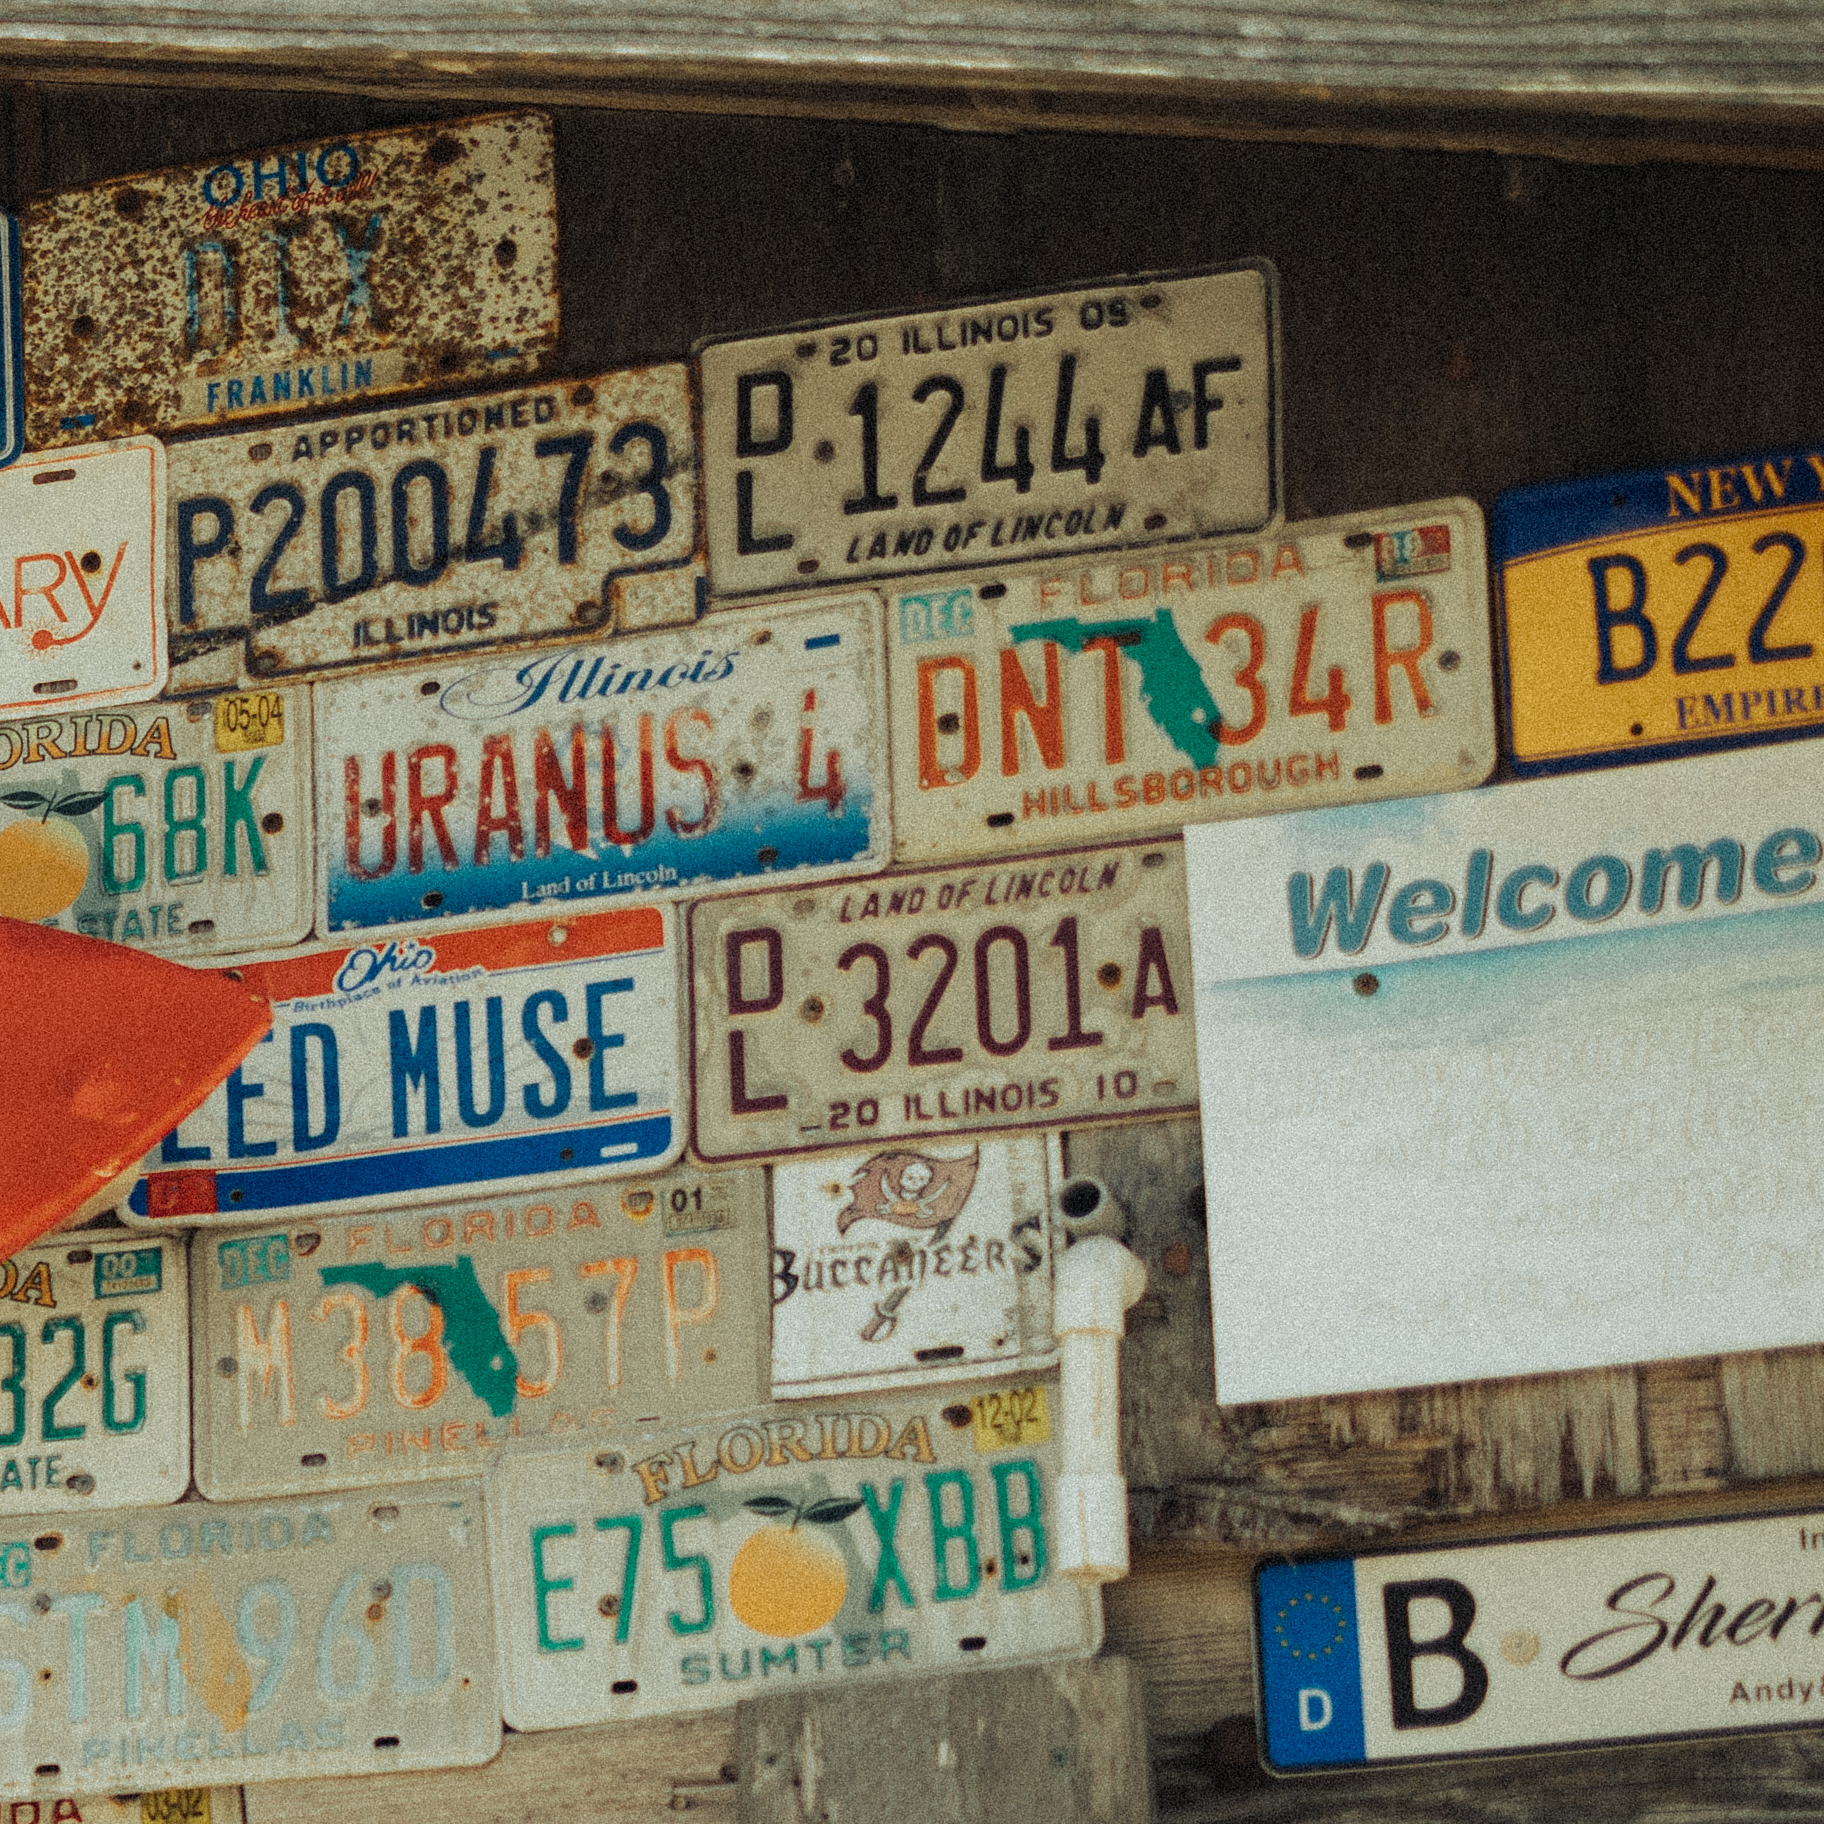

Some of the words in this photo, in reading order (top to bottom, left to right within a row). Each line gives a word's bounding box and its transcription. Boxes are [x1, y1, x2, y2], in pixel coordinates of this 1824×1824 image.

[208, 360, 373, 412] FRANKLIN
[828, 332, 880, 367] 20
[901, 310, 1055, 357] ILLINOIS
[844, 352, 1106, 515] 1244
[1133, 356, 1242, 459] AF
[177, 422, 671, 625] P200473
[847, 521, 933, 564] LAND
[943, 517, 977, 551] OF
[987, 505, 1126, 547] LINCOLN
[353, 601, 498, 650] ILLINOIS
[1204, 589, 1435, 746] 34R
[101, 754, 271, 899] 68K
[343, 706, 719, 882] URANUS
[1021, 753, 1341, 821] HILLSBOROUGH
[838, 880, 930, 924] LAND
[937, 876, 975, 912] OF
[985, 861, 1121, 907] LINCOLN
[1286, 827, 1823, 961] Welcome
[336, 942, 434, 994] Ohio
[836, 916, 1105, 1075] 3201
[1130, 926, 1179, 1021] A
[387, 975, 639, 1140] MUSE
[828, 1098, 881, 1131] 20
[902, 1076, 1060, 1123] ILLINOIS
[1095, 1069, 1139, 1099] 10
[632, 1409, 938, 1504] FLORIDA
[530, 1503, 714, 1654] E75
[679, 1628, 913, 1687] SUMTER
[1382, 1578, 1489, 1730] B
[1297, 1688, 1333, 1732] D
